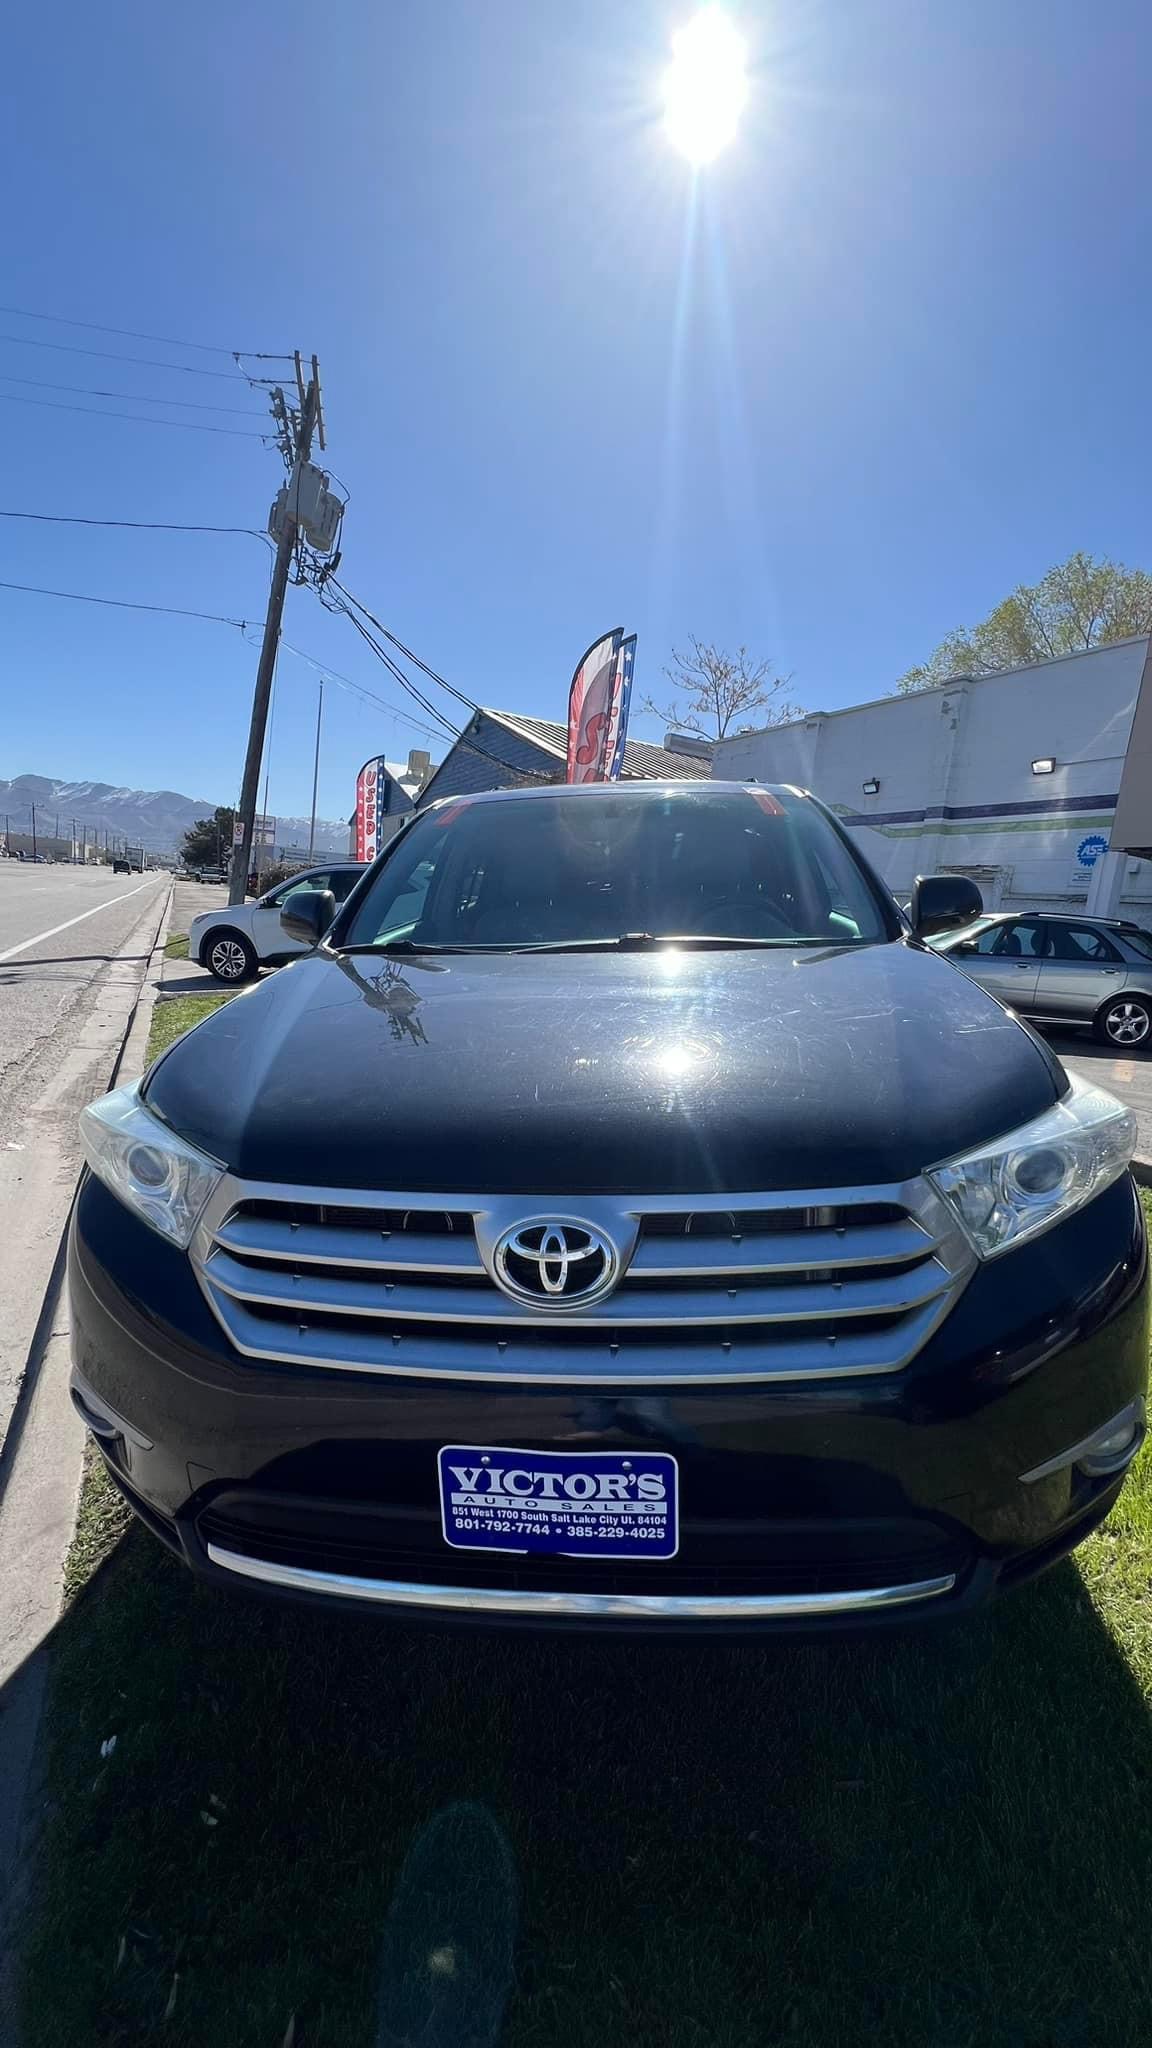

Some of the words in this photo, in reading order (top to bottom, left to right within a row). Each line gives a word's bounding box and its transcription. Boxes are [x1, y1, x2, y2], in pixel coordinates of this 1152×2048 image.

[365, 771, 377, 835] USED
[1081, 844, 1104, 855] ASE
[448, 1466, 666, 1500] VICTOR'S
[463, 1496, 538, 1507] AUTO
[561, 1502, 656, 1512] SALES
[452, 1506, 469, 1515] 851
[471, 1507, 495, 1517] West
[497, 1510, 519, 1519] 1700
[521, 1511, 549, 1522] South
[551, 1513, 571, 1523] Salt
[573, 1514, 597, 1524] Lake
[599, 1515, 619, 1527] City
[620, 1516, 635, 1525] Ut.
[638, 1516, 667, 1525] 84104
[455, 1518, 550, 1535] 801-792-7744
[567, 1526, 665, 1539] 385-229-4025
